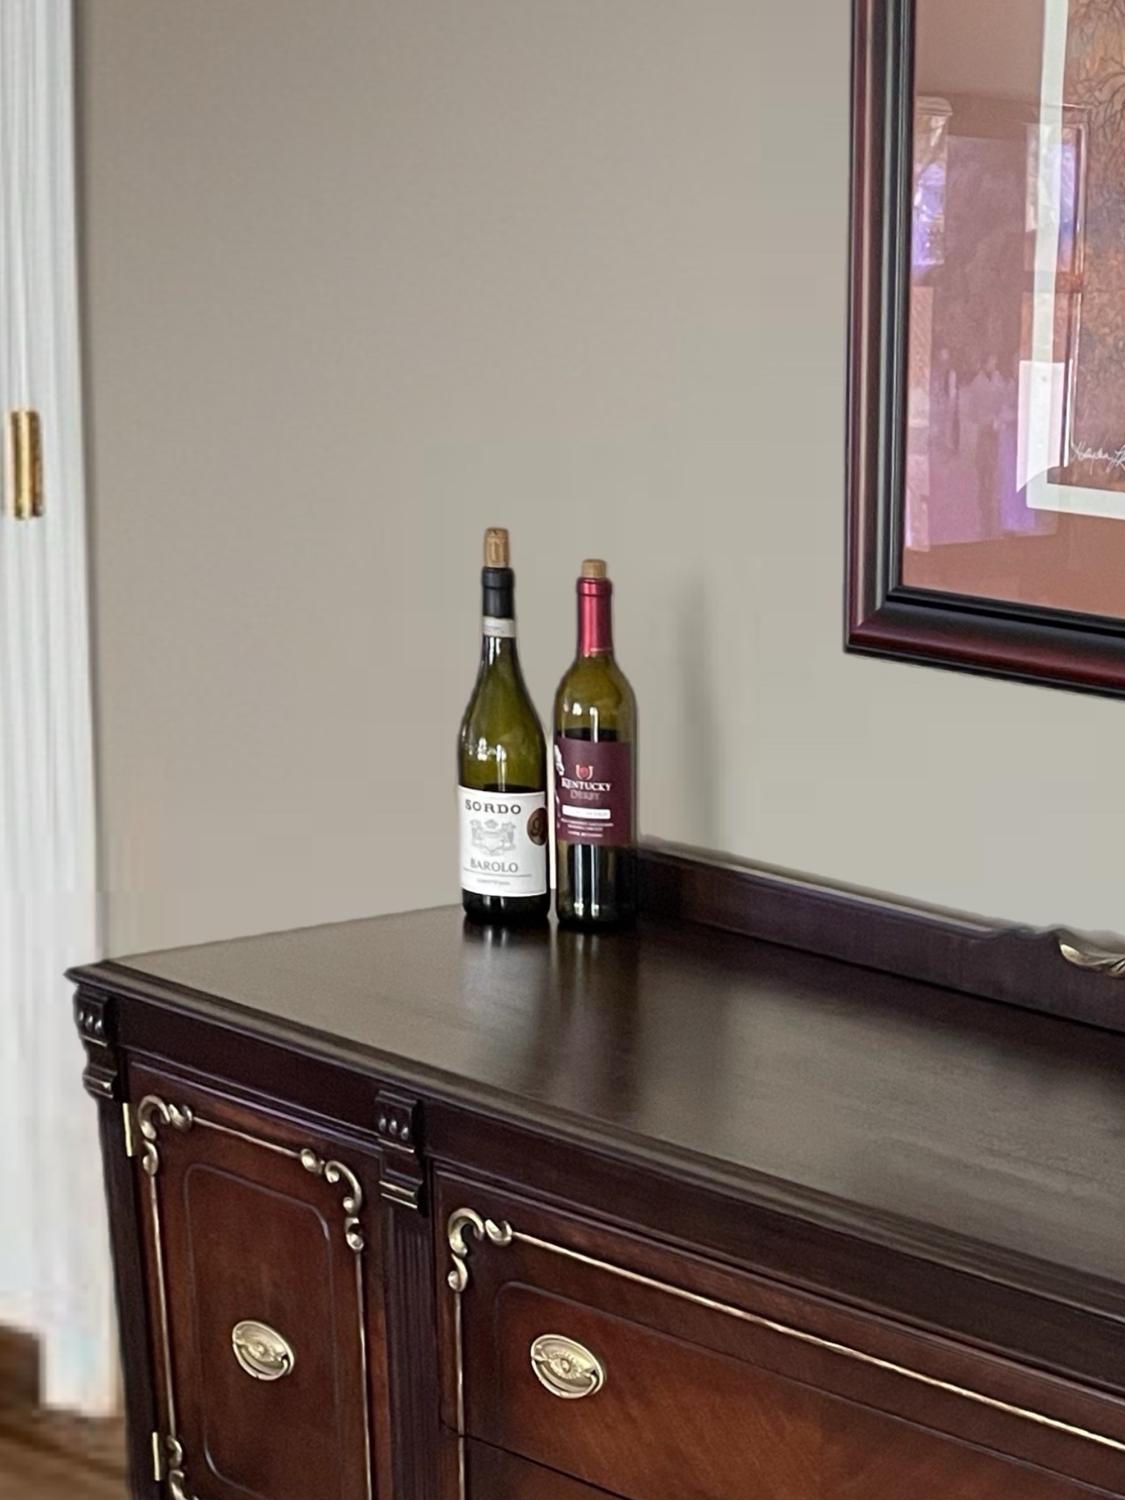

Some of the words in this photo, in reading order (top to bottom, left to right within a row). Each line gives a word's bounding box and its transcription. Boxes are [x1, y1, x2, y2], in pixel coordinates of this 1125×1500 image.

[561, 777, 612, 791] KENTUCKY
[465, 799, 522, 815] SORDO
[470, 858, 519, 873] BAROLO
